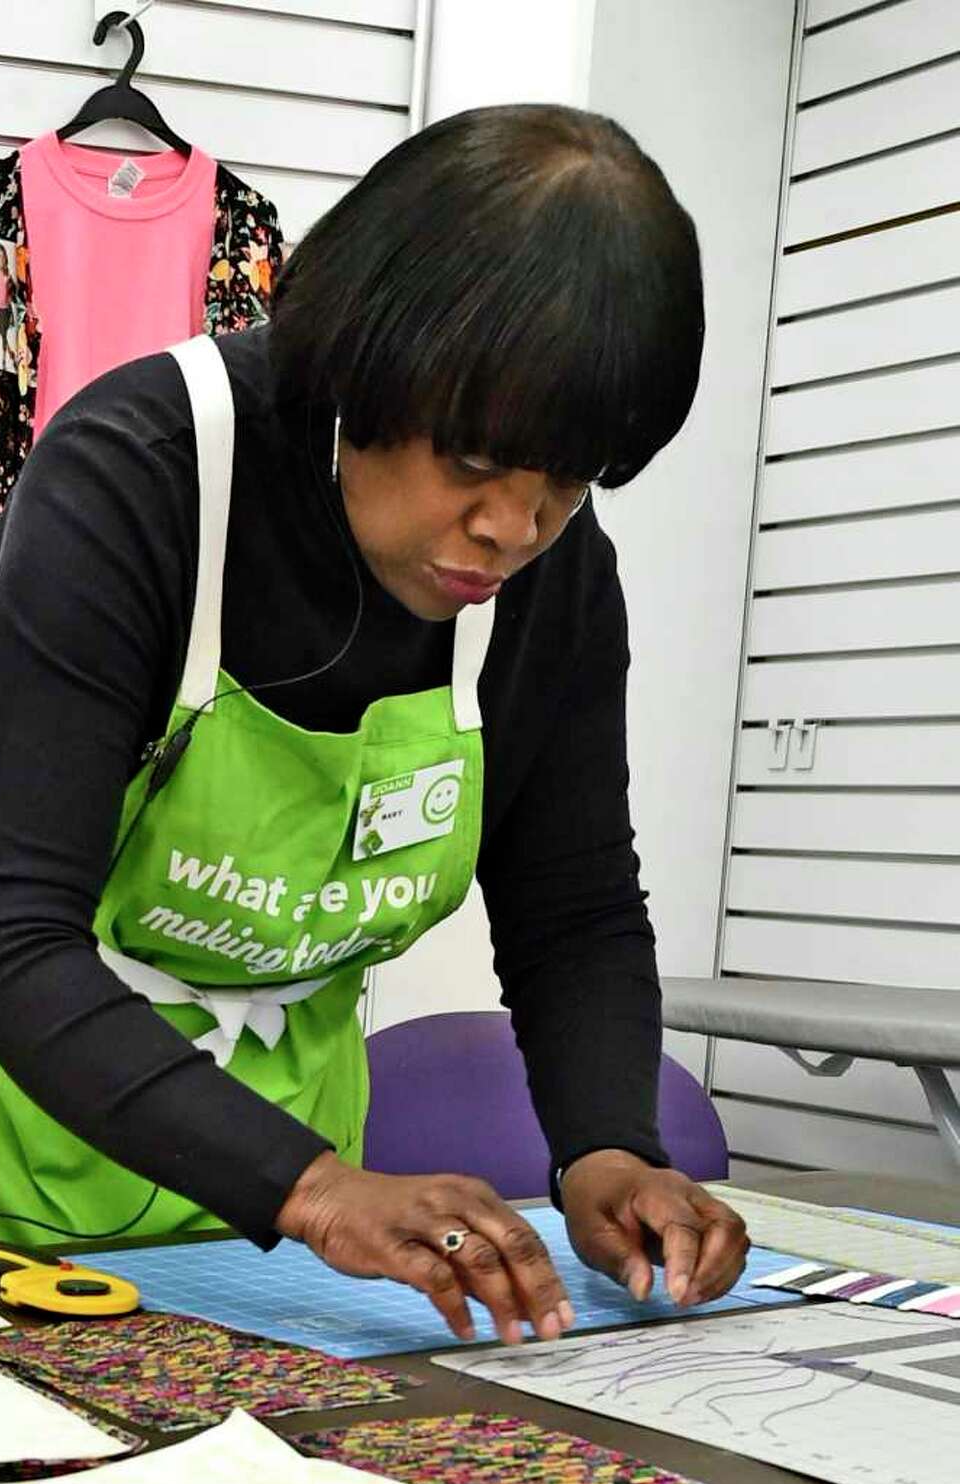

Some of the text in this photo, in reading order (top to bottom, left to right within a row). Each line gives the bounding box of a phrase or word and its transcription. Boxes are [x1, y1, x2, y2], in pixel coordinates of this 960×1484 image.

[168, 850, 437, 923] what ae you
[139, 904, 393, 975] making toda
